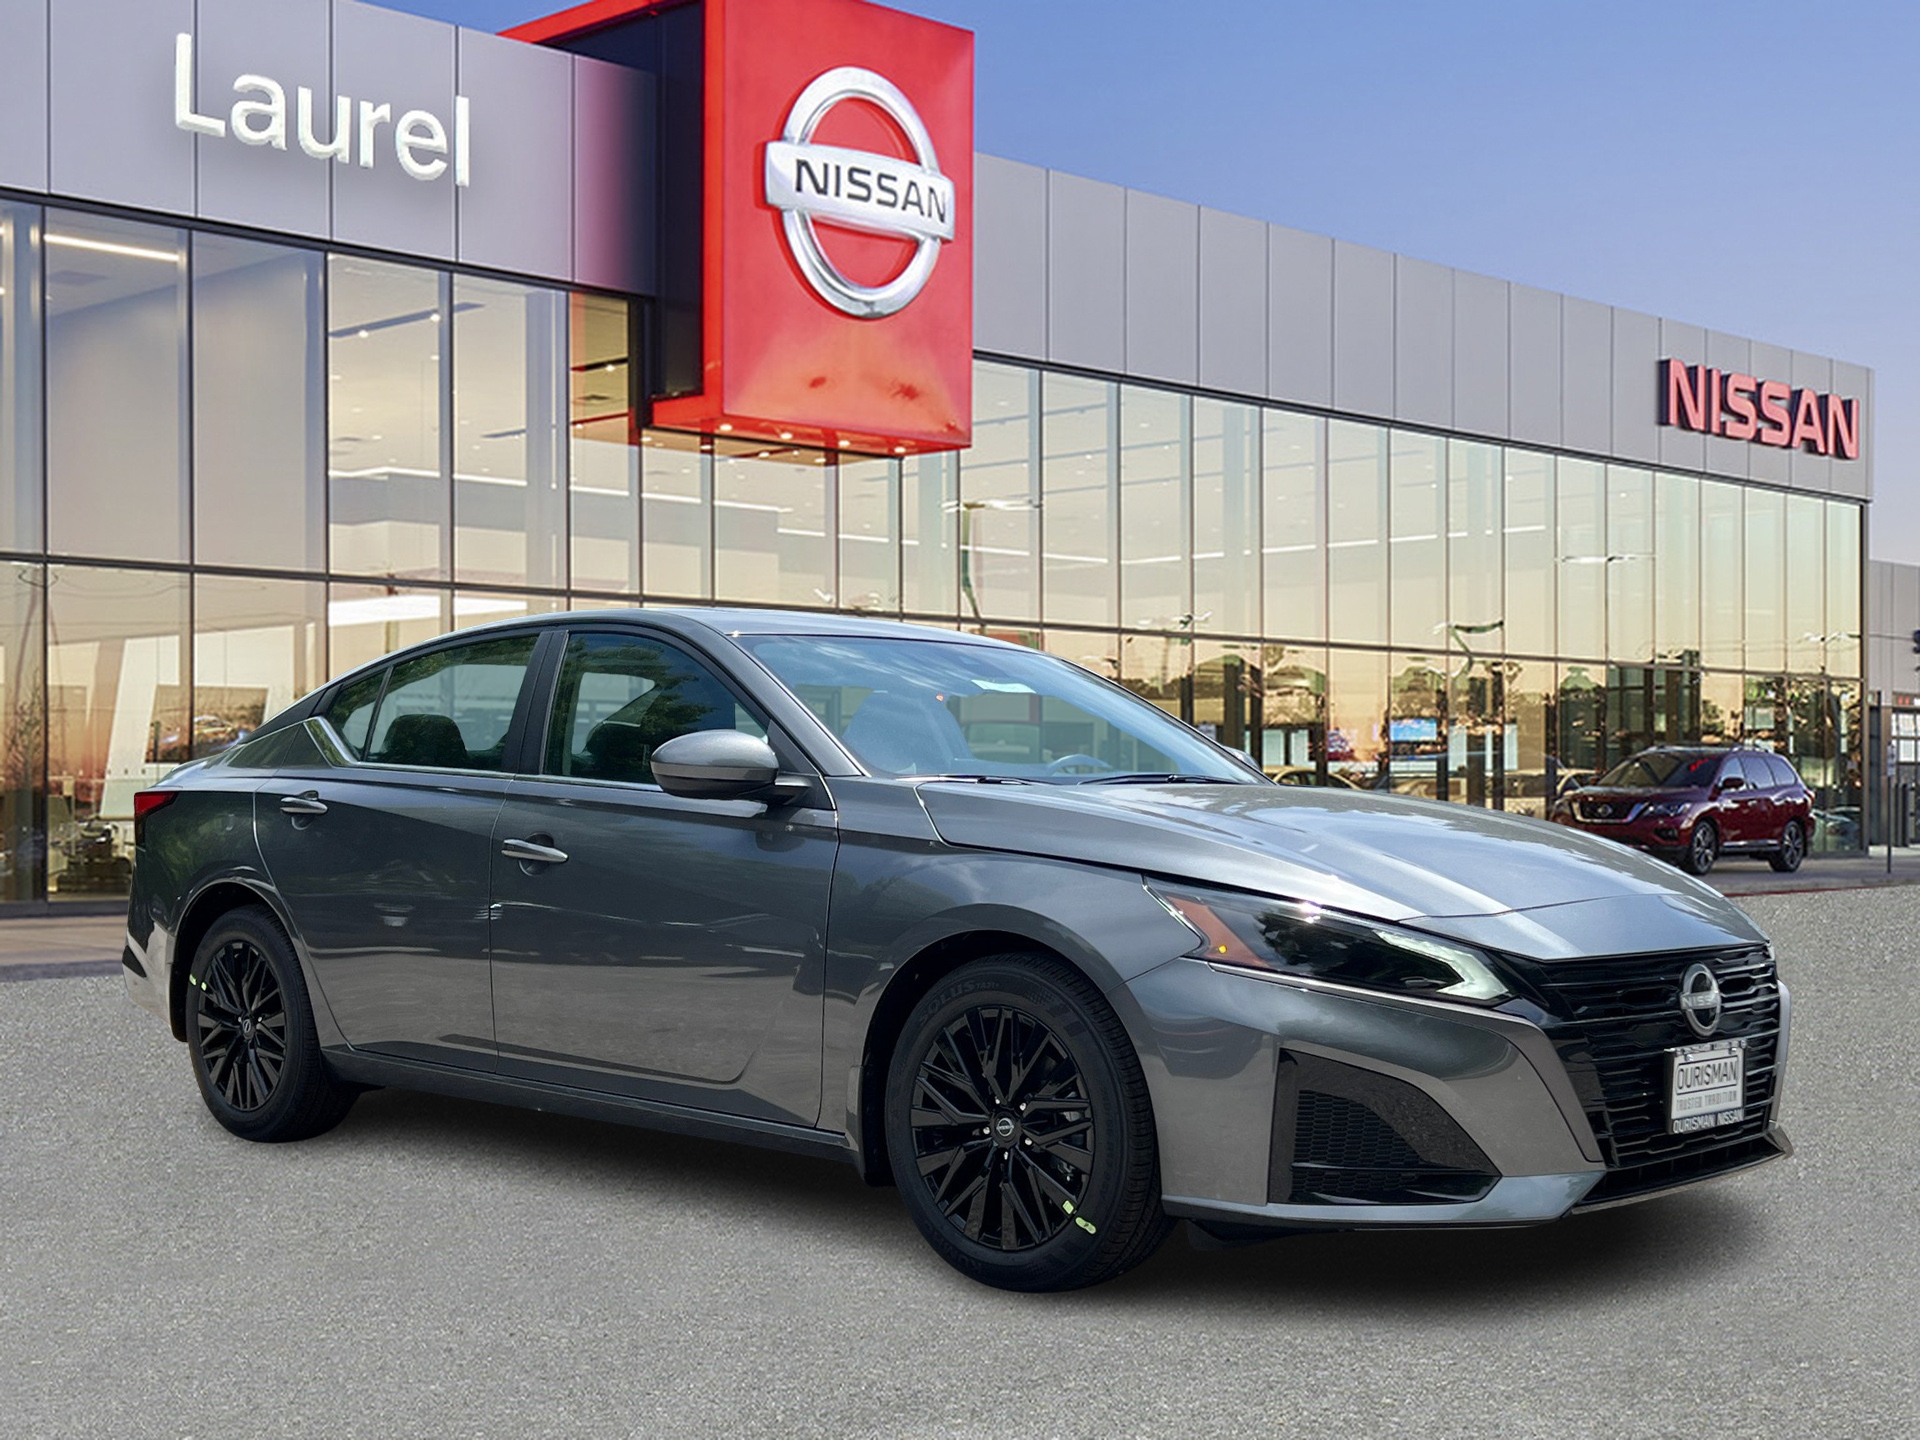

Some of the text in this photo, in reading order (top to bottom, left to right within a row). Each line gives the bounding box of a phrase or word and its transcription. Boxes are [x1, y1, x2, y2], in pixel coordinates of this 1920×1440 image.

[175, 32, 470, 188] Laurel
[795, 158, 946, 223] NISSAN
[1658, 358, 1859, 460] NISSAN
[1677, 1061, 1738, 1090] OURISMAN
[1673, 1108, 1744, 1134] OURISMAN NISSAN
